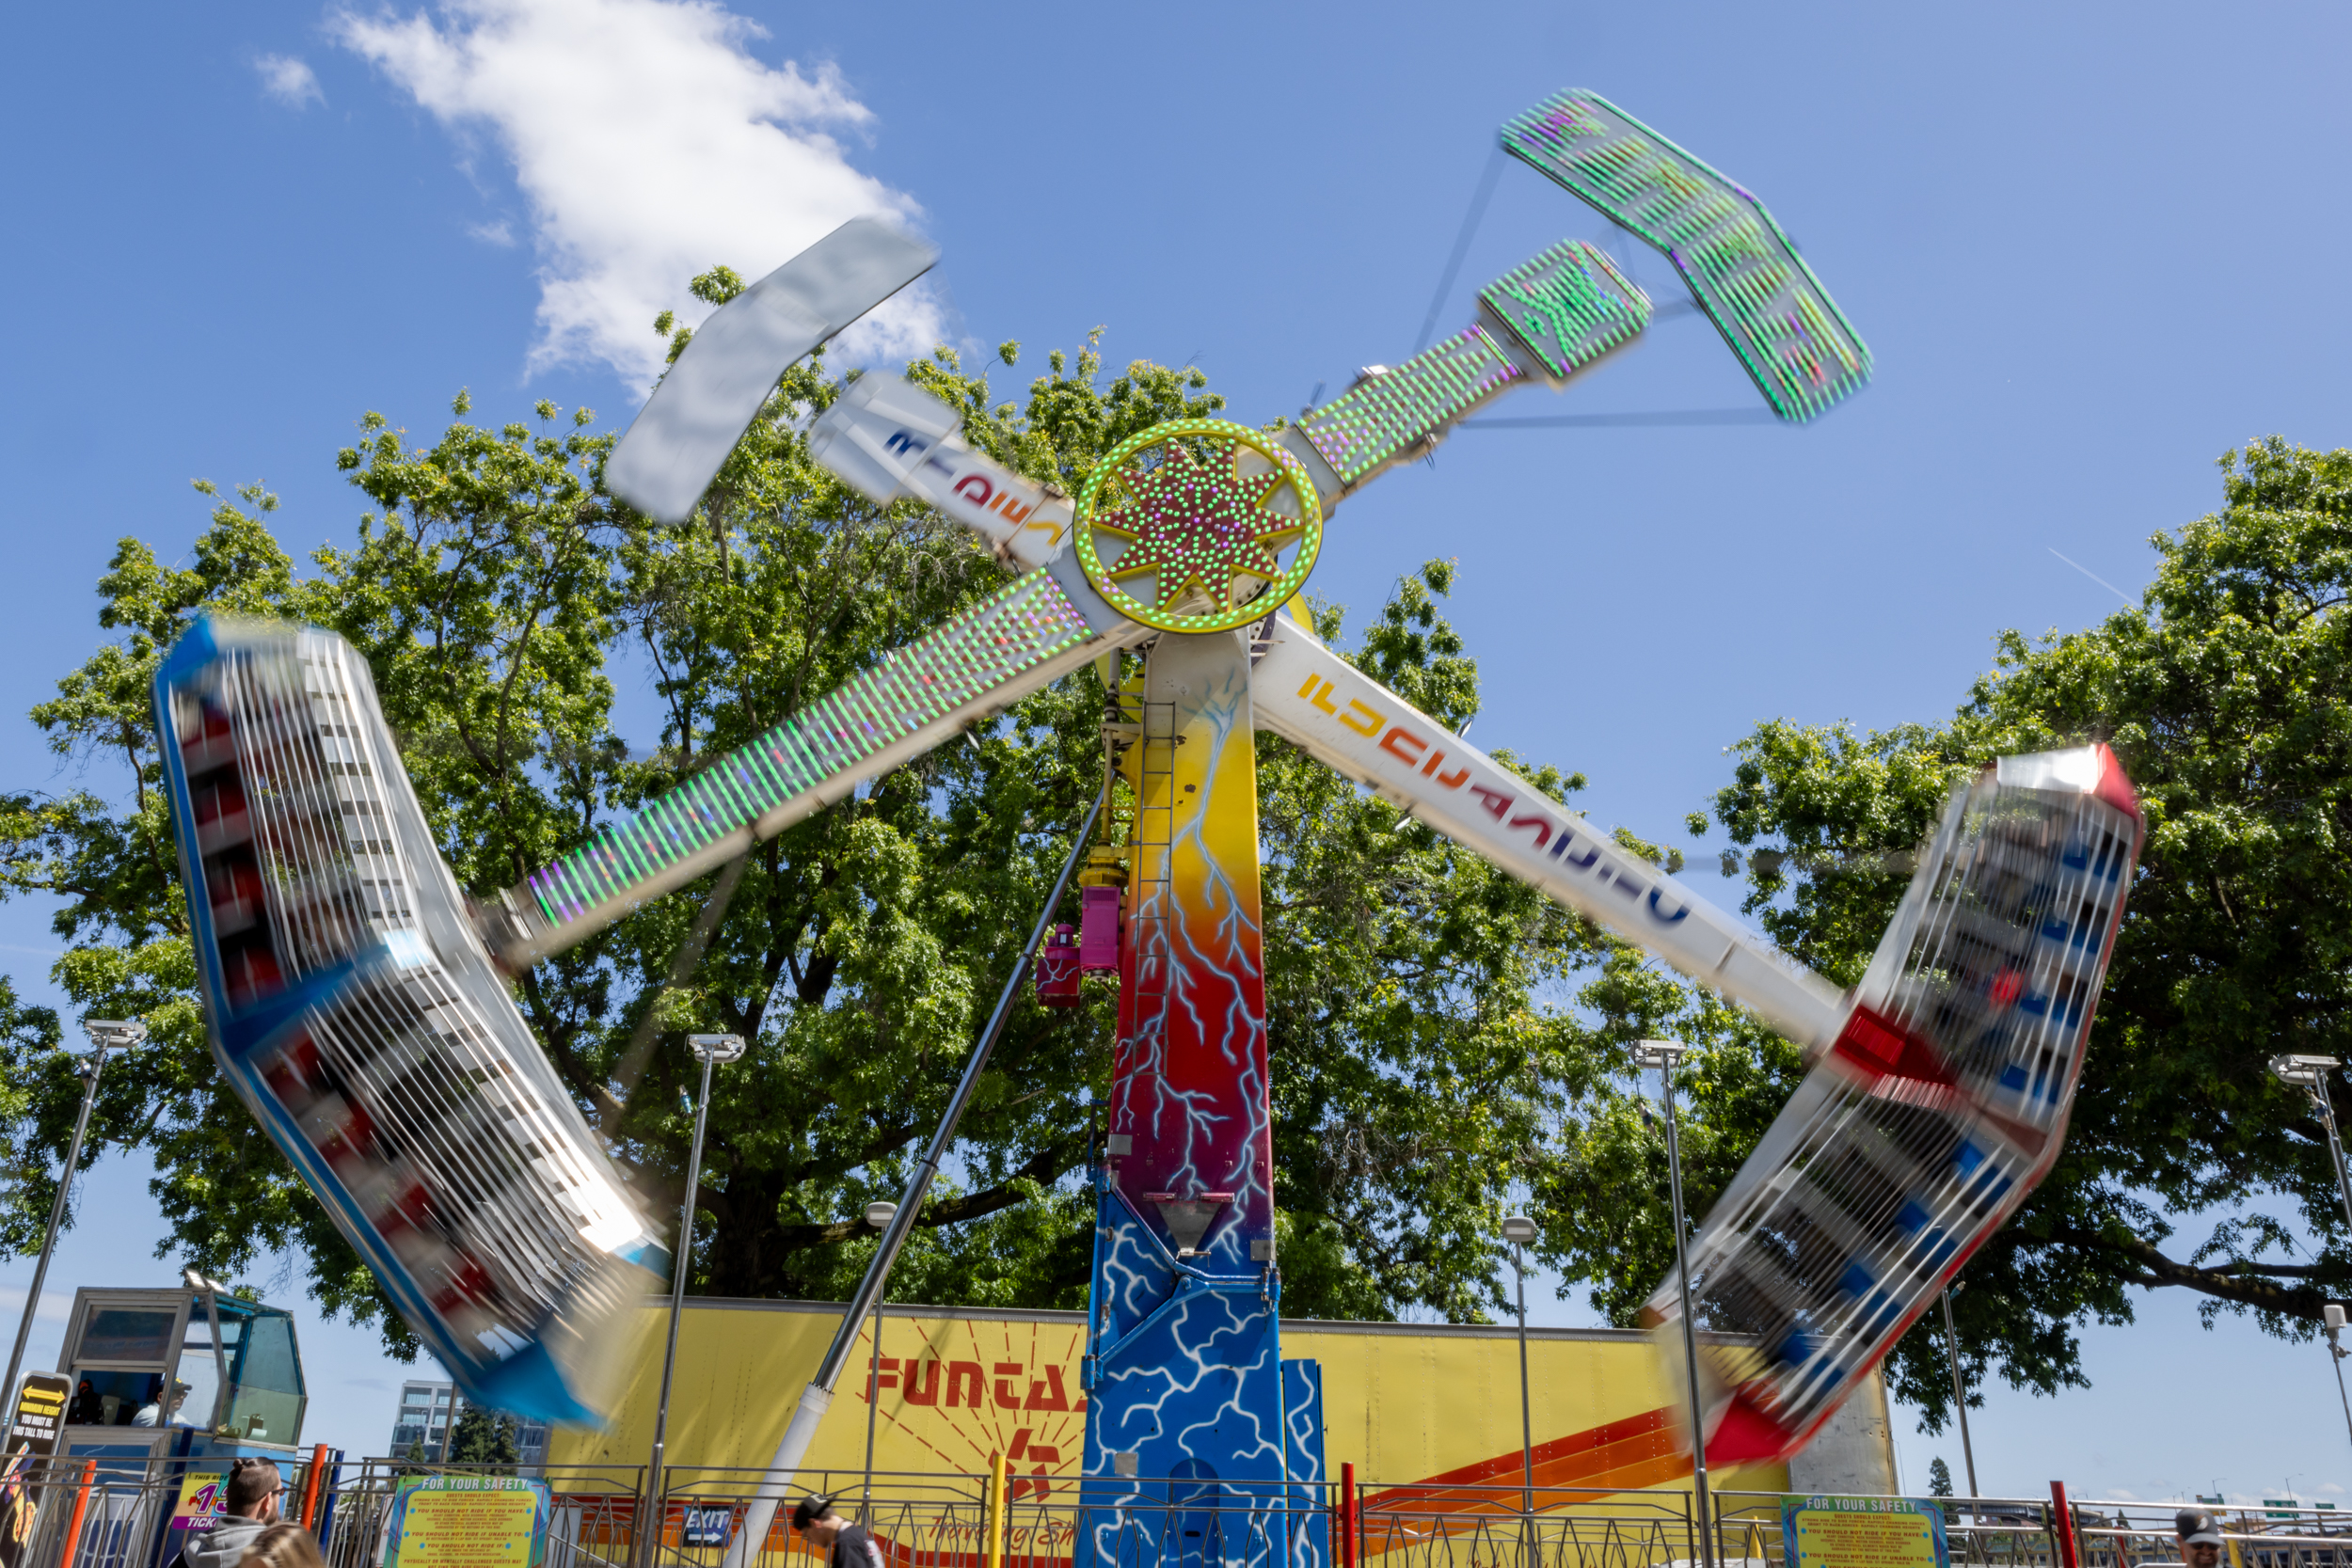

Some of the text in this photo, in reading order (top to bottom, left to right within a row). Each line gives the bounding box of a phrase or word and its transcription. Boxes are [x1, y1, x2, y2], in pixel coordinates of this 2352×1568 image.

[864, 1357, 1088, 1413] FUNTA
[19, 1402, 61, 1417] MINIMUM HEIGHT
[21, 1414, 54, 1428] YOU MUST BE
[12, 1425, 56, 1440] THIS TALL TO RIDE
[421, 1478, 529, 1490] FOR YOUR SAFETY
[1806, 1497, 1916, 1513] FOR YOUR SAFETY
[187, 1517, 217, 1528] TICK
[686, 1510, 729, 1528] EXIT
